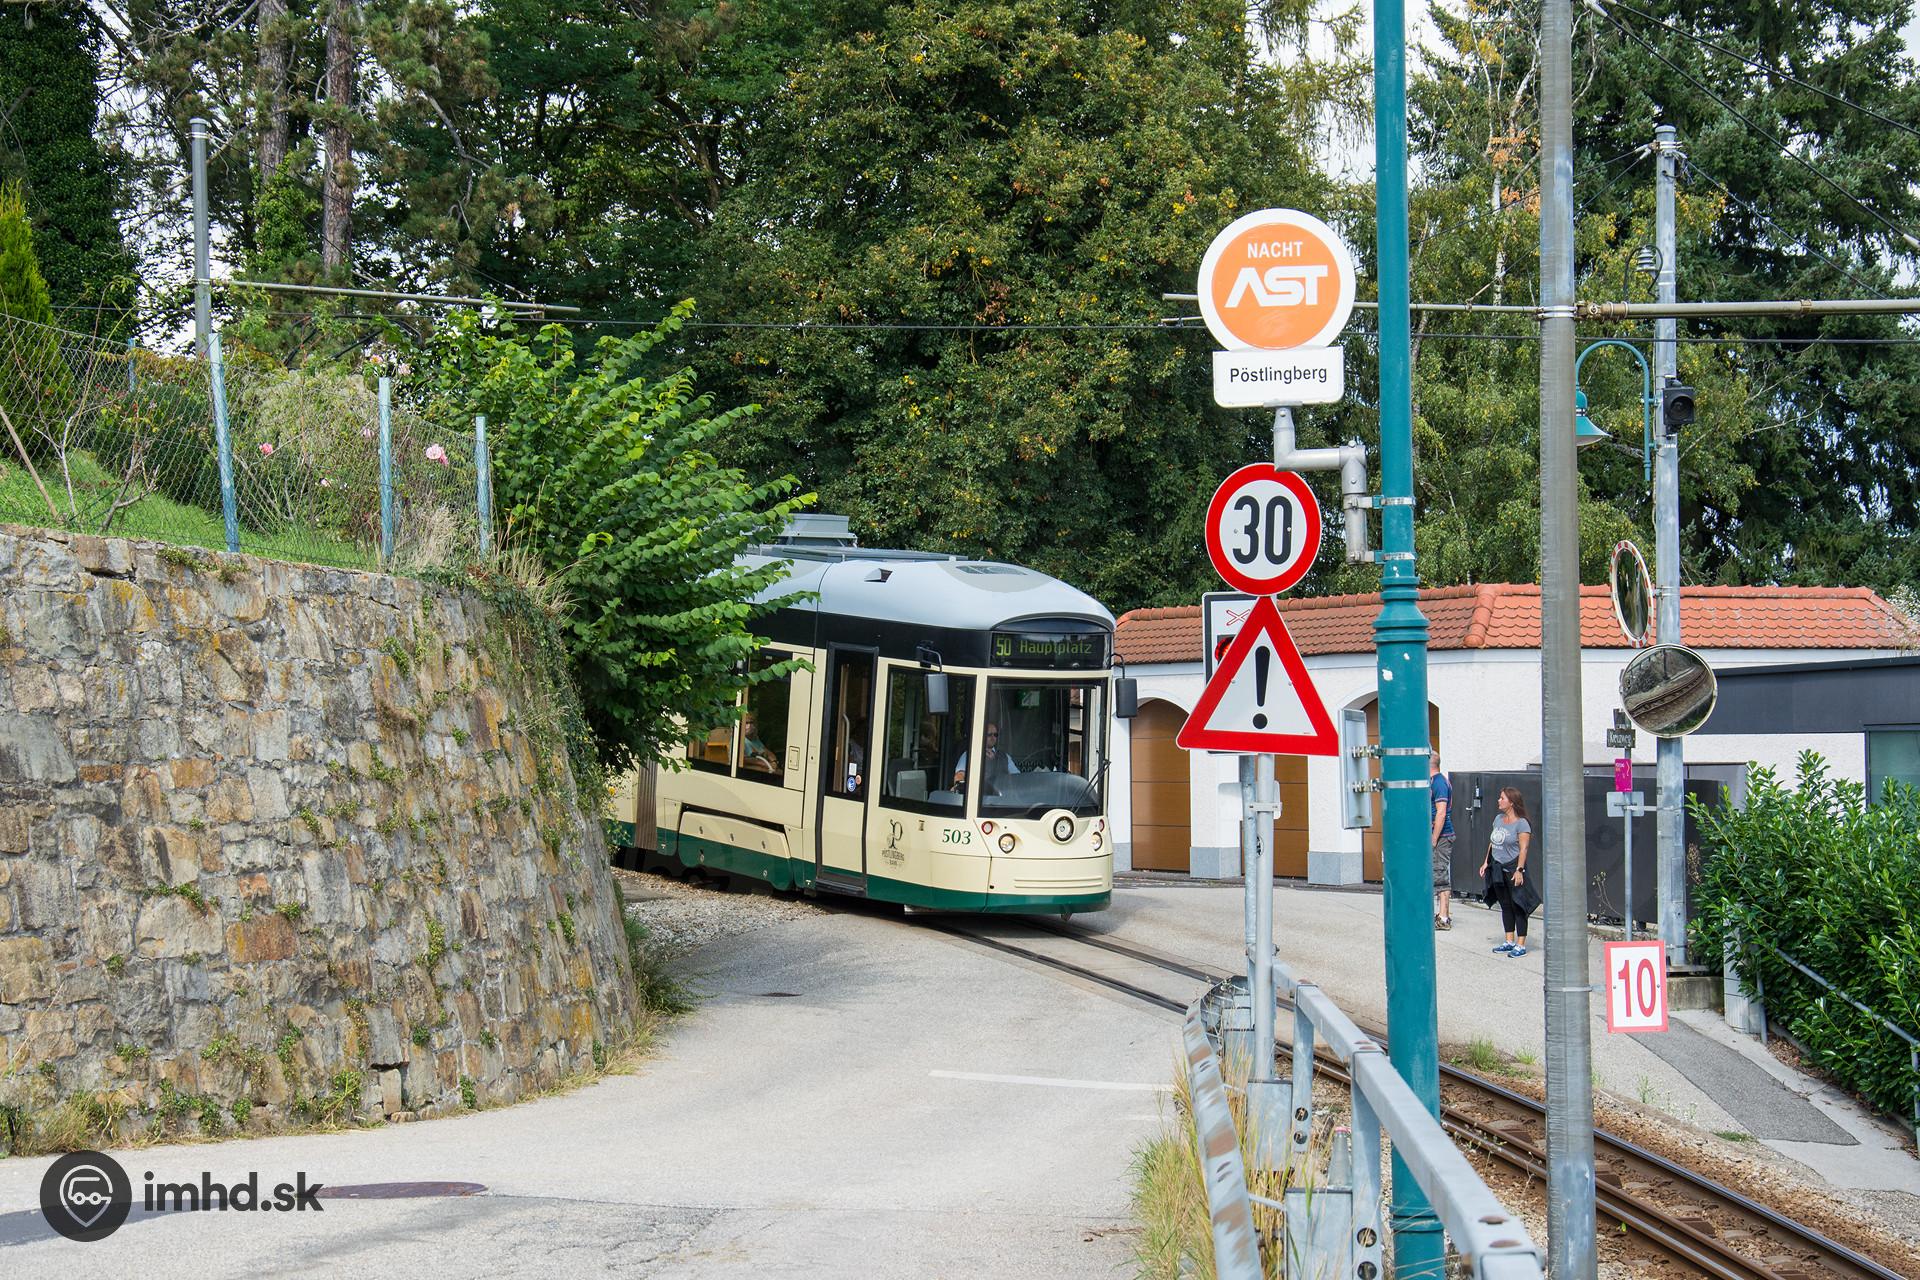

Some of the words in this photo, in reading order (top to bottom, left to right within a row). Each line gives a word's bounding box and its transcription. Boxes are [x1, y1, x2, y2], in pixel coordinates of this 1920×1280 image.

[1247, 241, 1303, 259] NACHT
[1224, 265, 1328, 308] AST
[1230, 366, 1327, 384] Pöstlingberg
[1232, 495, 1293, 565] 30
[996, 638, 1011, 656] 50
[1019, 639, 1092, 656] Hauptplatz
[942, 829, 971, 845] 503
[1618, 958, 1656, 1017] 10
